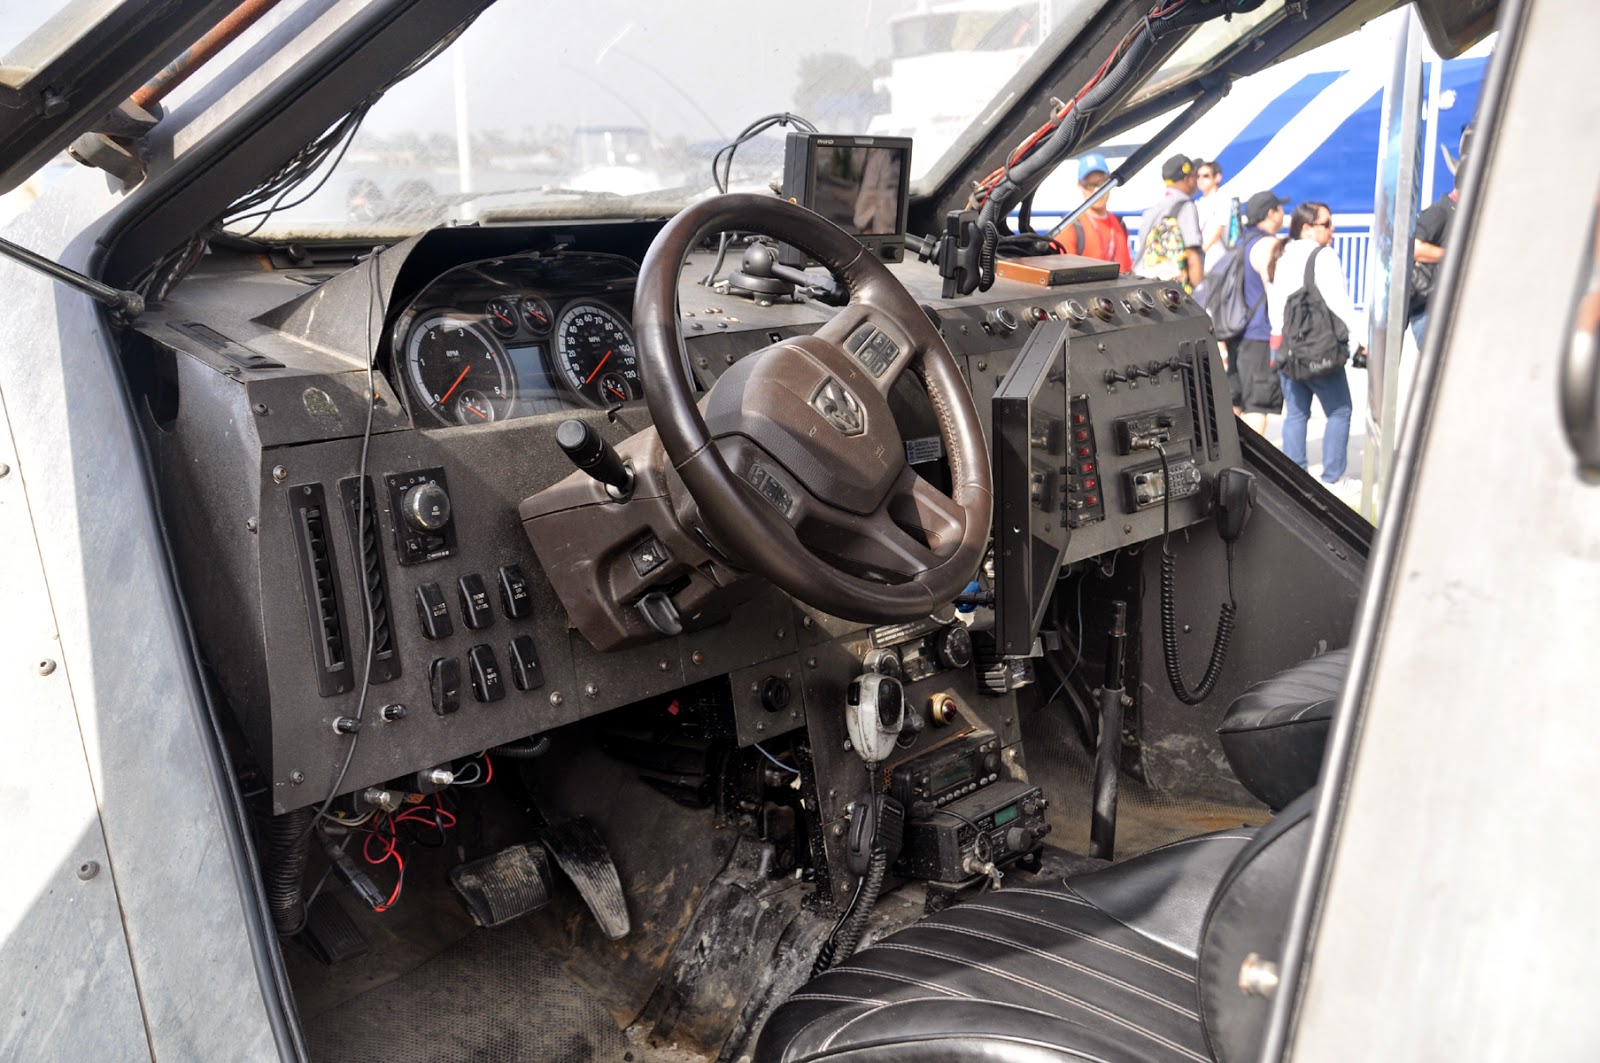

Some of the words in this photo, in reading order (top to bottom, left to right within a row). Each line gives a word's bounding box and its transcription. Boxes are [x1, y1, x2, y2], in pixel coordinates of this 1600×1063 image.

[575, 318, 584, 326] 50
[584, 314, 592, 322] 60
[594, 316, 603, 325] 70
[569, 325, 577, 333] 40
[605, 322, 613, 331] 80
[614, 332, 623, 340] 90
[567, 336, 575, 345] 30
[619, 343, 630, 352] 100
[567, 350, 576, 358] 20
[624, 357, 635, 365] 110
[572, 363, 580, 371] 10
[624, 370, 636, 379] 120
